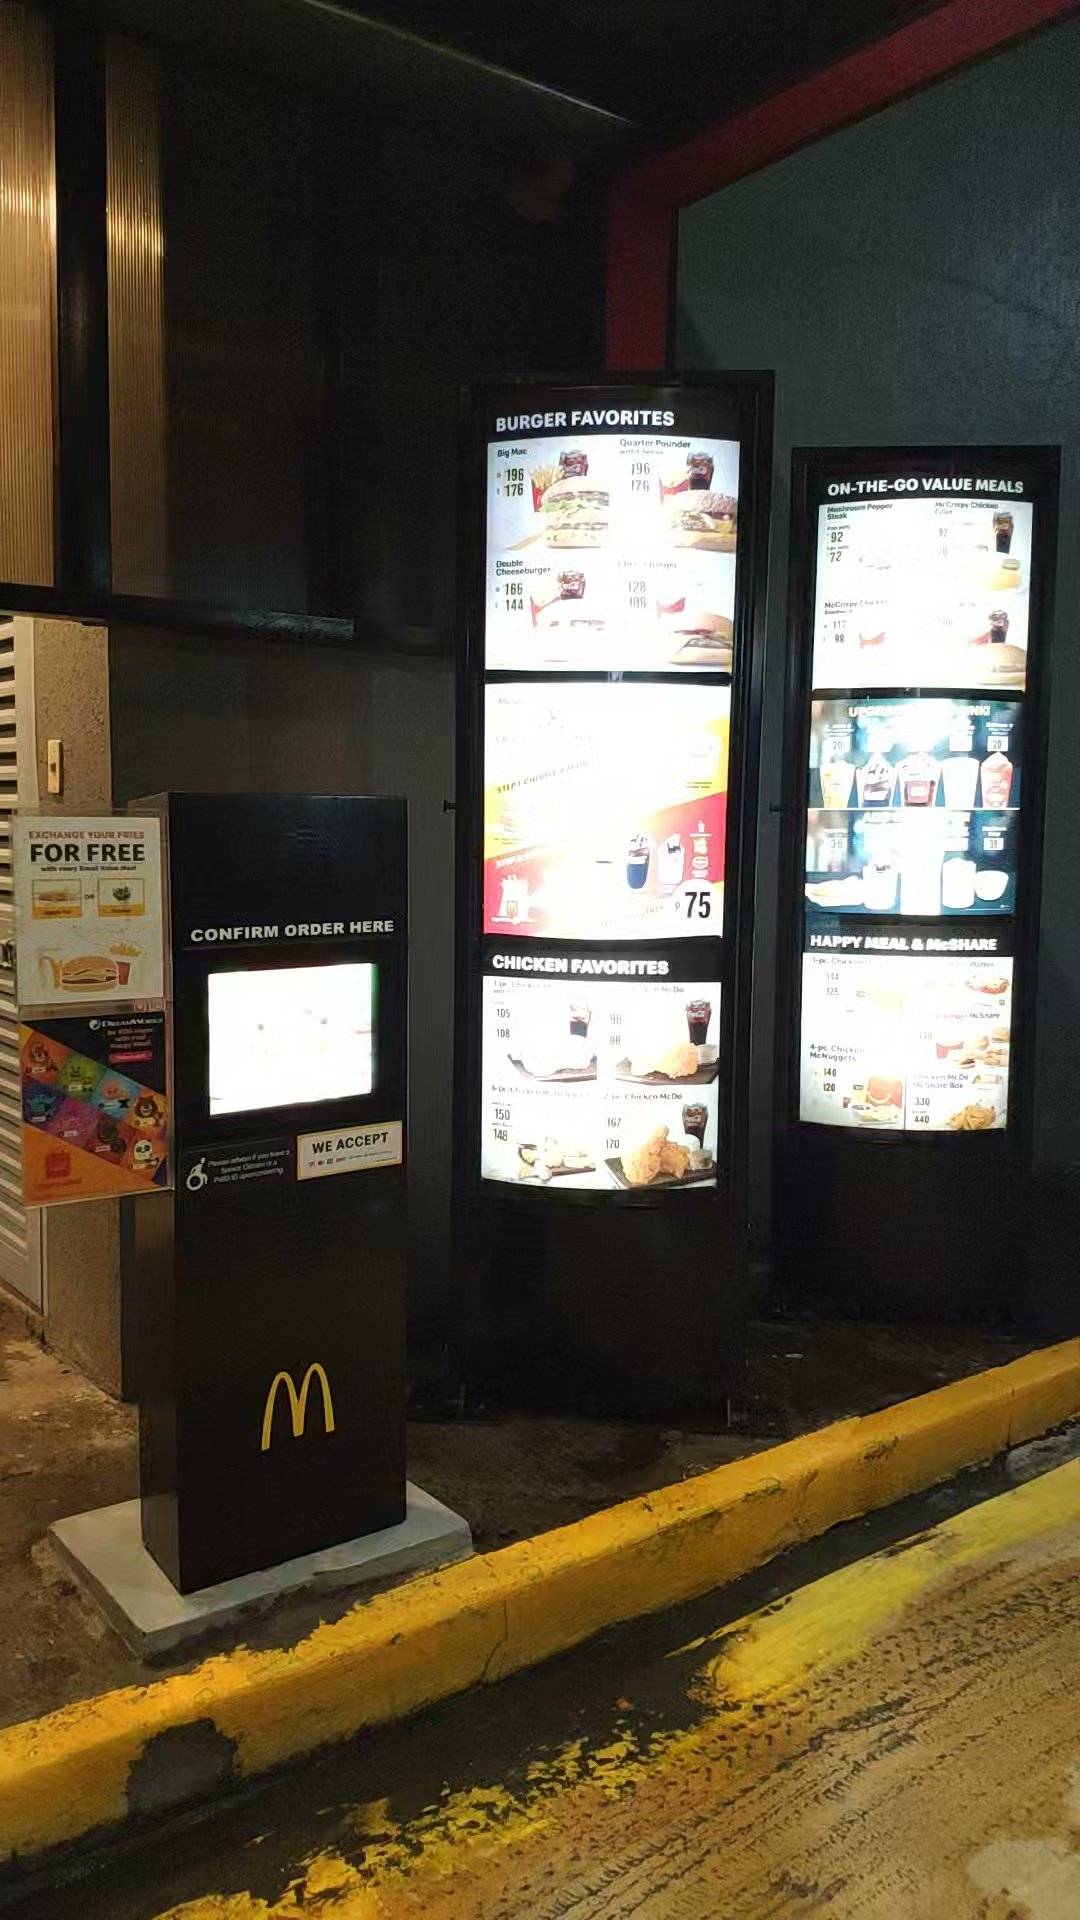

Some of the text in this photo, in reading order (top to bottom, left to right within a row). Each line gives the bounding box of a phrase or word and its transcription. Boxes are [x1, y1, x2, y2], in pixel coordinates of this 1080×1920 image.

[496, 410, 675, 433] BURGER FAVORITES
[619, 438, 692, 449] Quarter Pounder
[497, 447, 528, 459] Big Mac
[506, 468, 524, 482] 196
[631, 463, 650, 475] 196
[504, 483, 524, 497] 176
[631, 479, 650, 492] 176
[828, 477, 1024, 497] ON-THE-GO VALUE MEALS
[831, 532, 844, 543] 92
[829, 552, 842, 563] 72
[496, 560, 524, 569] Double
[496, 566, 551, 577] Cheeseburger
[628, 581, 646, 593] 128
[505, 599, 524, 611] 144
[993, 740, 1003, 749] 20
[28, 830, 145, 840] EXCHANGE YOUR FRIES
[30, 843, 145, 862] FOR FREE
[684, 891, 712, 919] 75
[190, 919, 395, 942] CONFIRM ORDER HERE
[810, 935, 998, 951] HAPPY MEAL & McSHARE
[492, 954, 670, 976] CHICKEN FAVORITES
[496, 1028, 511, 1039] 108
[823, 1068, 837, 1078] 140
[823, 1083, 836, 1092] 120
[494, 1108, 511, 1121] 150
[914, 1115, 930, 1124] 440
[493, 1129, 508, 1142] 148
[312, 1132, 389, 1154] WE ACCEPT
[605, 1139, 620, 1150] 170
